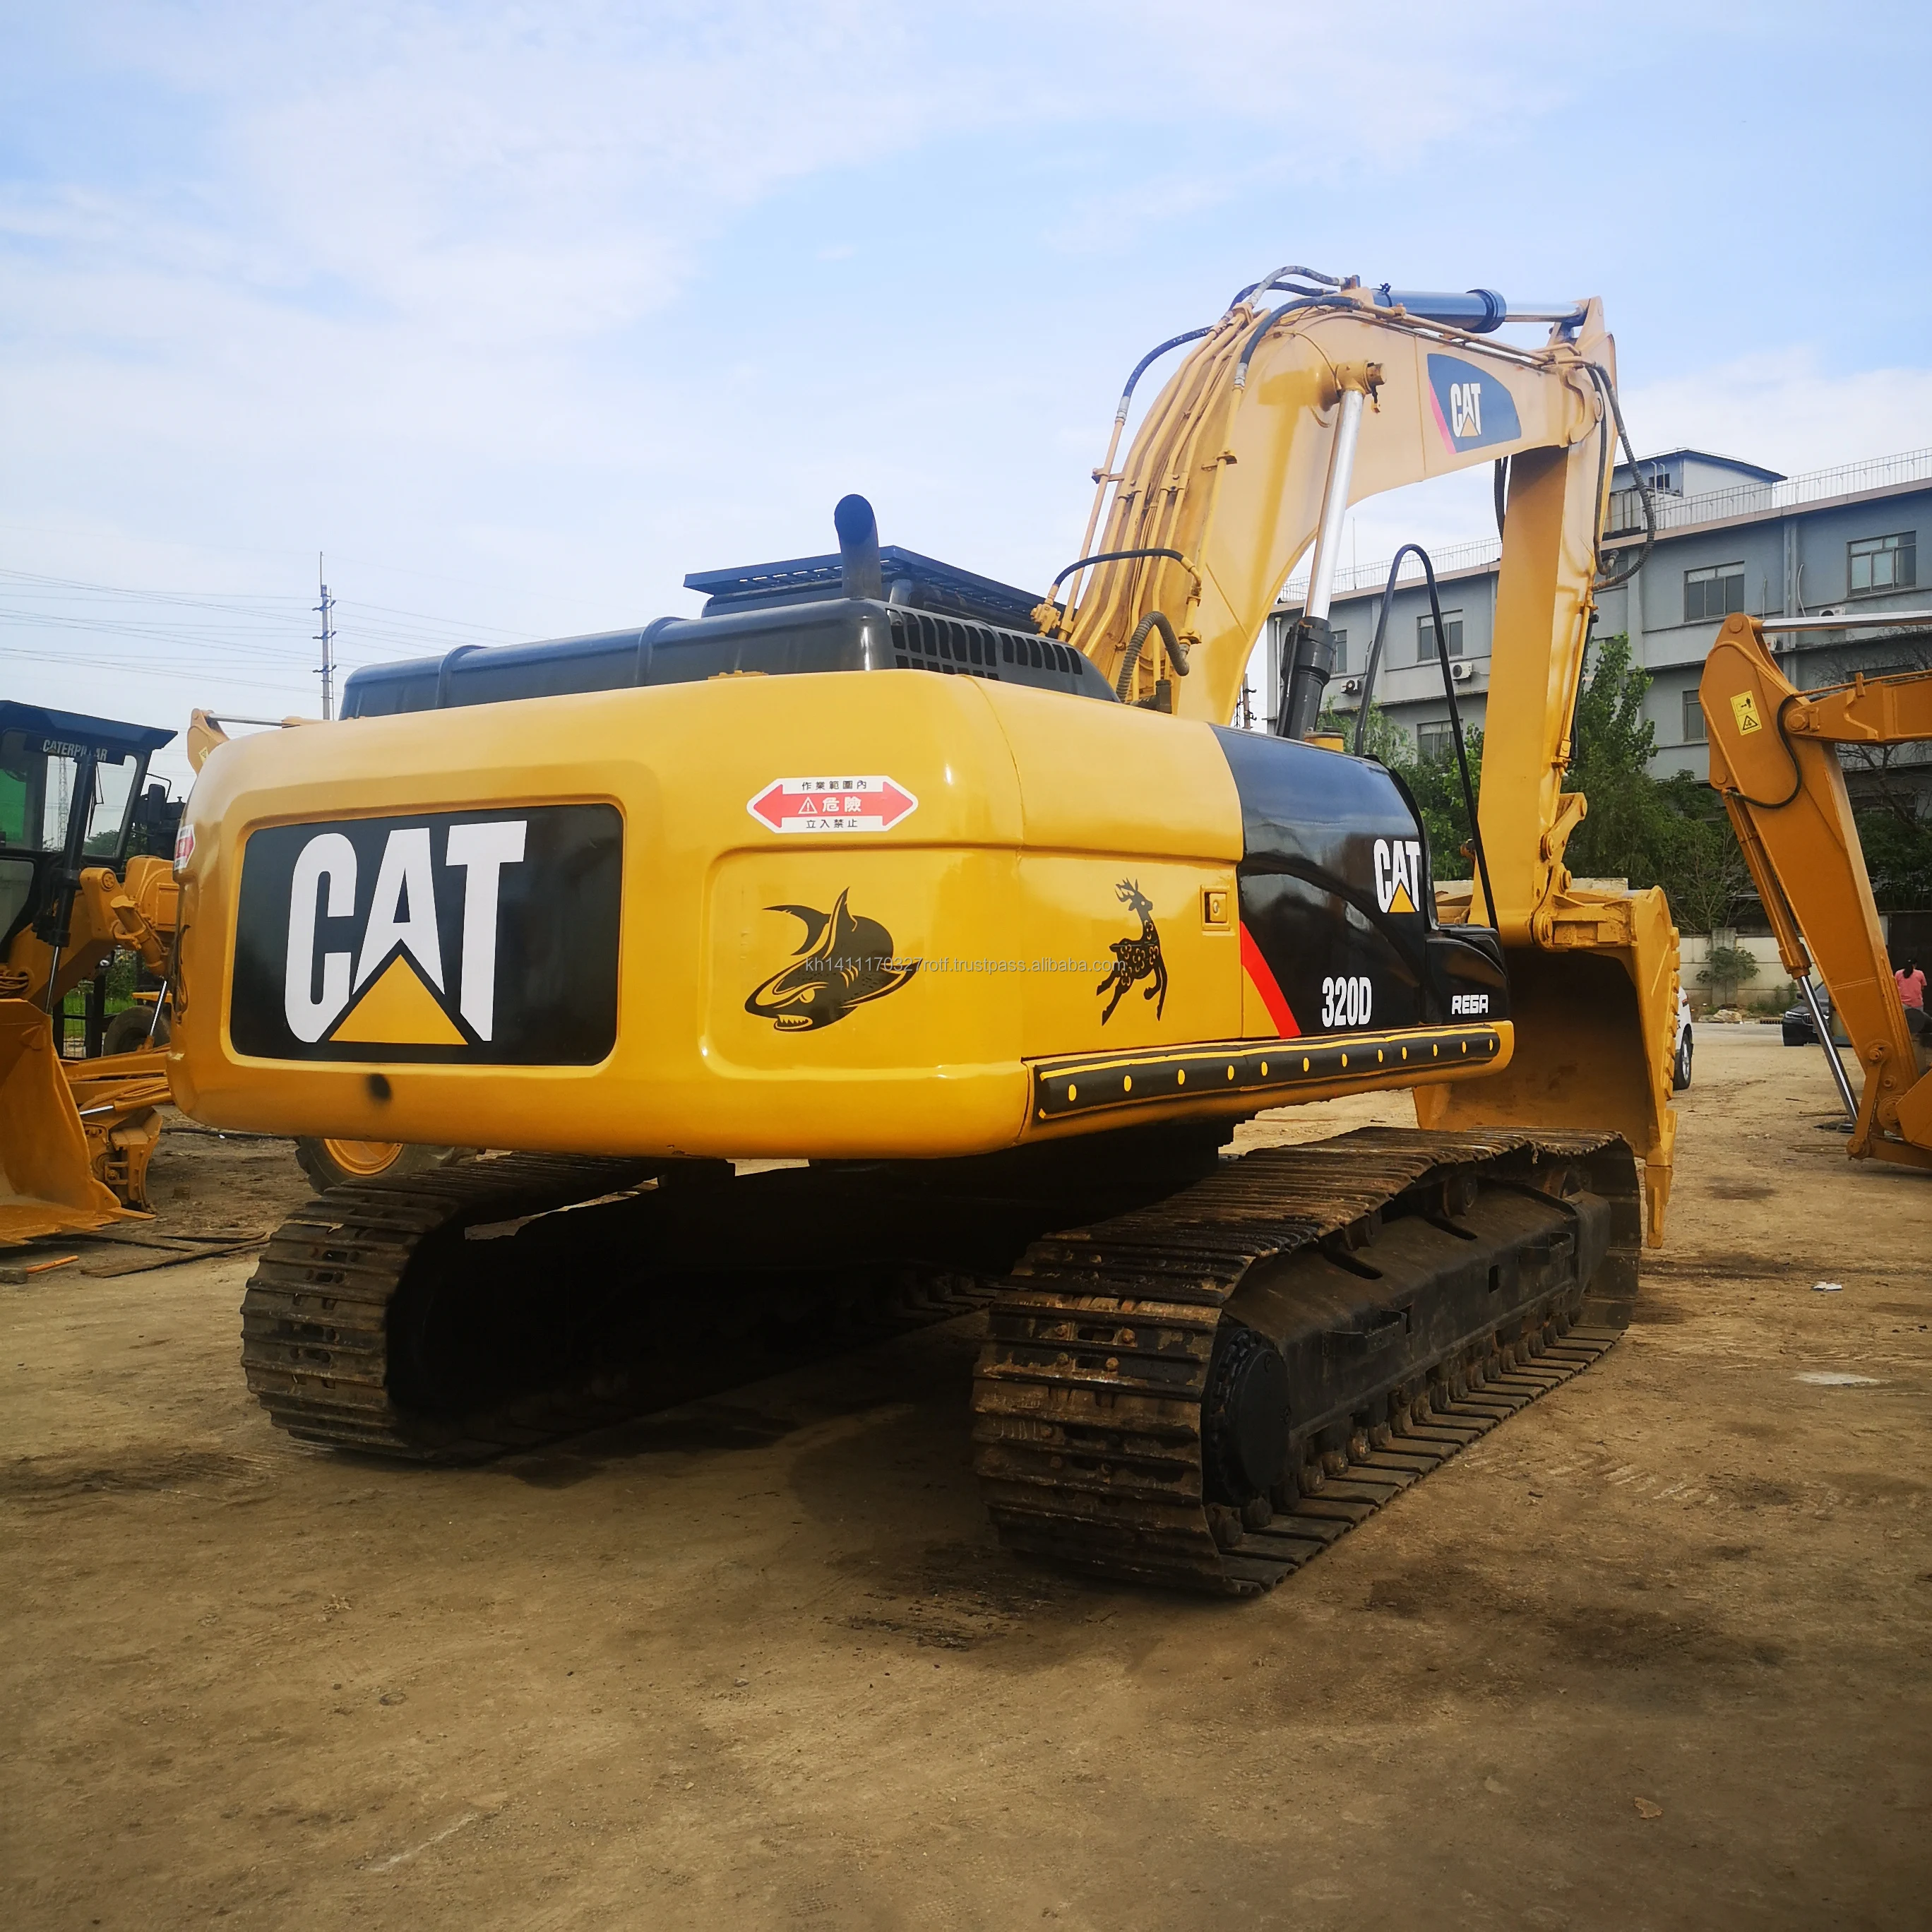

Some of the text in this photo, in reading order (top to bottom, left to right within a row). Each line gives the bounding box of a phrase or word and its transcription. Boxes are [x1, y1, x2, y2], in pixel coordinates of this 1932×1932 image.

[1450, 383, 1481, 437] CAT
[806, 818, 858, 829] 立入禁止
[822, 796, 862, 813] 危險
[1373, 838, 1421, 913] CAT
[285, 821, 527, 1043] CAT
[1322, 977, 1372, 1027] 320D
